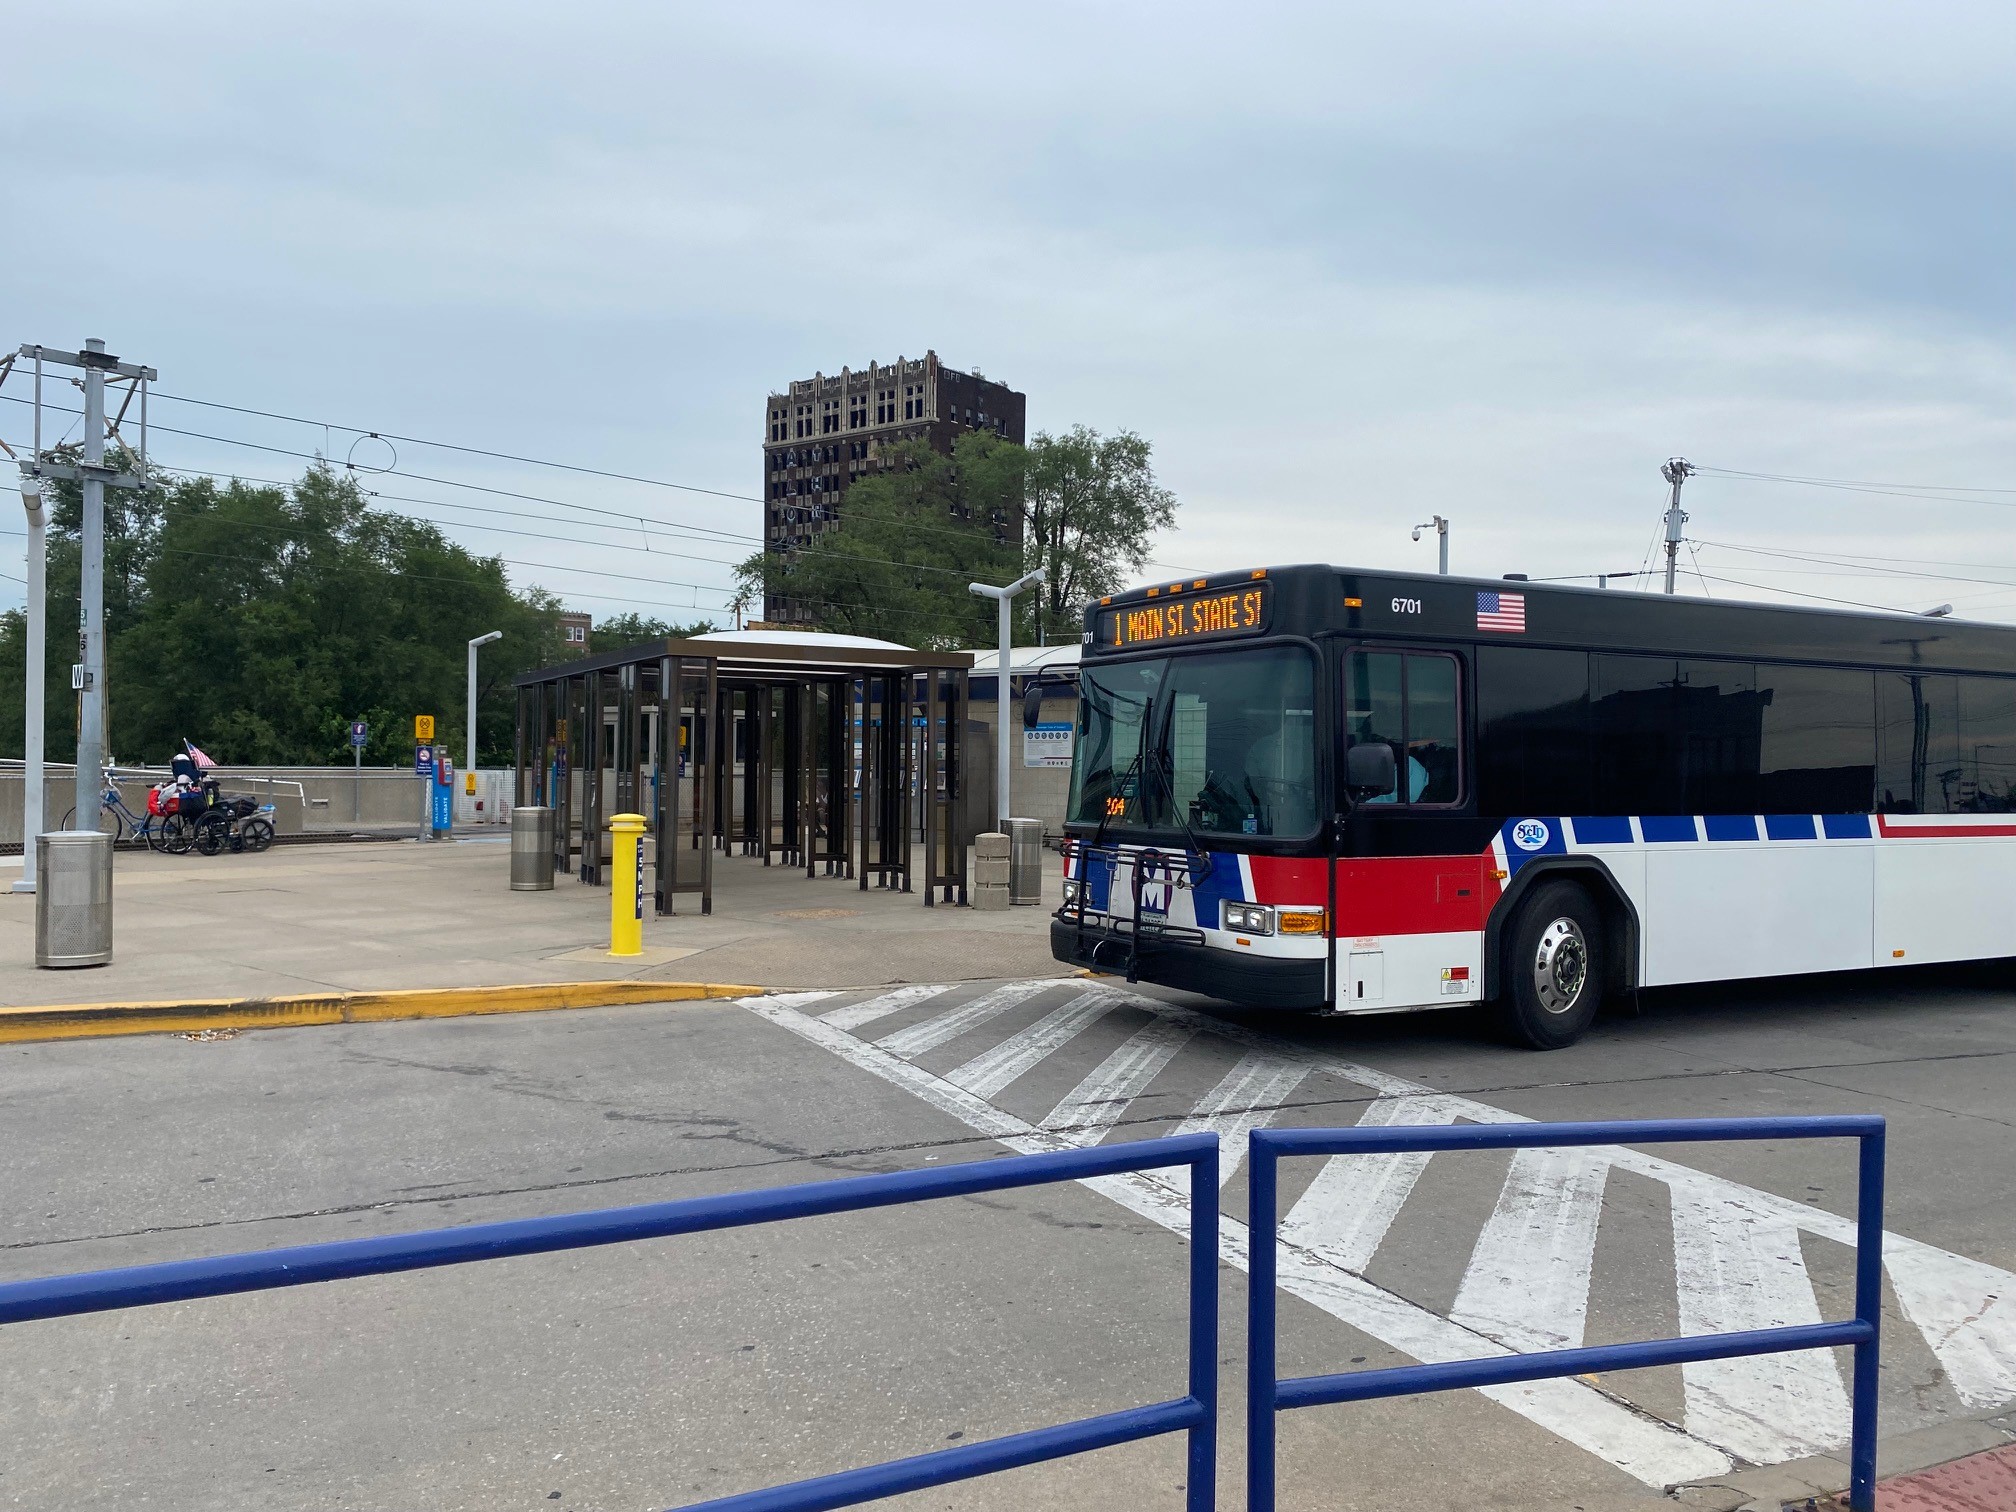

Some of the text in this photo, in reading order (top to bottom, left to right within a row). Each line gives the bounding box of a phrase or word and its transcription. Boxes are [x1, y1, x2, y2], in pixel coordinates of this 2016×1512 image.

[1391, 597, 1422, 614] 6701
[1114, 612, 1122, 646] 1
[1127, 607, 1163, 642] MAIN
[1167, 604, 1189, 636] ST.
[1192, 595, 1239, 633] STATE
[74, 667, 83, 687] W
